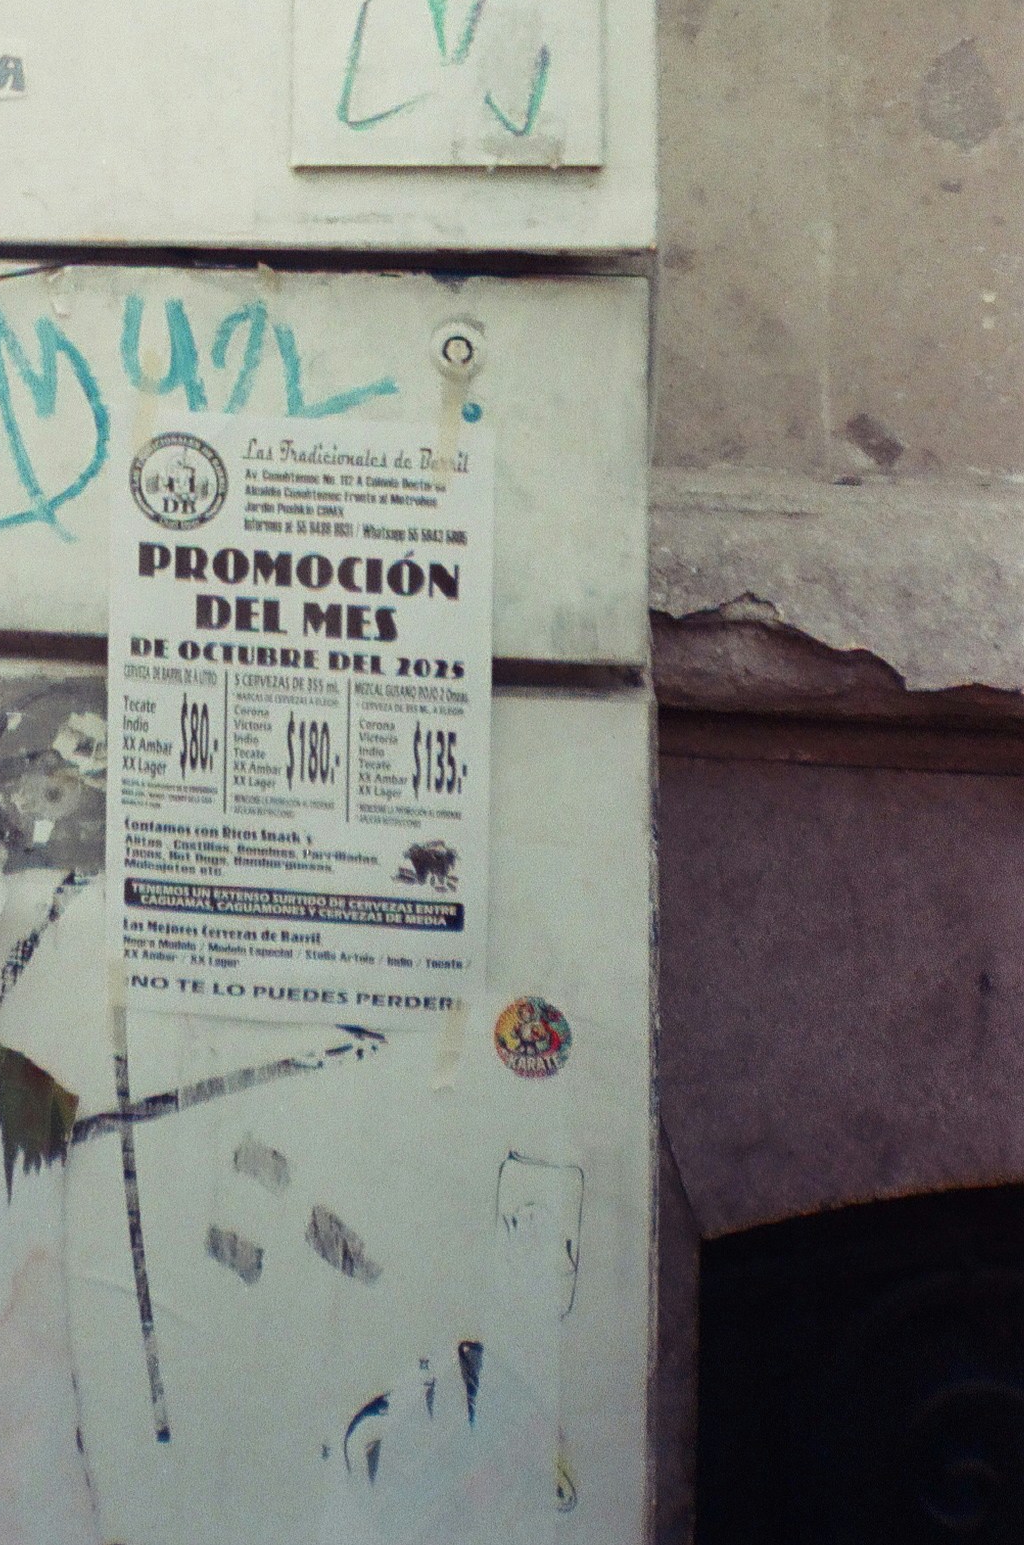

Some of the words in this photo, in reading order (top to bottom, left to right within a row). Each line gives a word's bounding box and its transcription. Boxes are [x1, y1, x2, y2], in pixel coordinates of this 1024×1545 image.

[137, 541, 461, 601] PROMOCIÓN
[195, 593, 288, 635] DEL
[302, 600, 399, 643] MES
[130, 636, 170, 661] DE
[177, 639, 320, 671] OCTUBRE
[328, 652, 386, 676] DEL
[396, 657, 466, 680] 2025
[242, 672, 289, 690] CERVEZAS
[292, 676, 304, 691] DE
[123, 695, 156, 714] Tecate
[123, 714, 149, 733] Indio
[122, 736, 136, 751] XX
[138, 737, 173, 755] Ambar
[122, 756, 136, 771] XX
[138, 757, 167, 780] Lager
[124, 817, 191, 836] Contamos
[194, 825, 218, 839] con
[222, 825, 257, 842] Ricos
[131, 882, 189, 898] TENEMOS
[192, 887, 210, 899] UN
[213, 888, 270, 904] EXTENSO
[272, 892, 327, 908] SURTIDO
[328, 896, 346, 908] DE
[348, 897, 413, 914] CERVEZAS
[416, 902, 456, 917] ENTRE
[176, 978, 206, 994] TE
[212, 982, 246, 998] LO
[253, 985, 349, 1005] PUEDES
